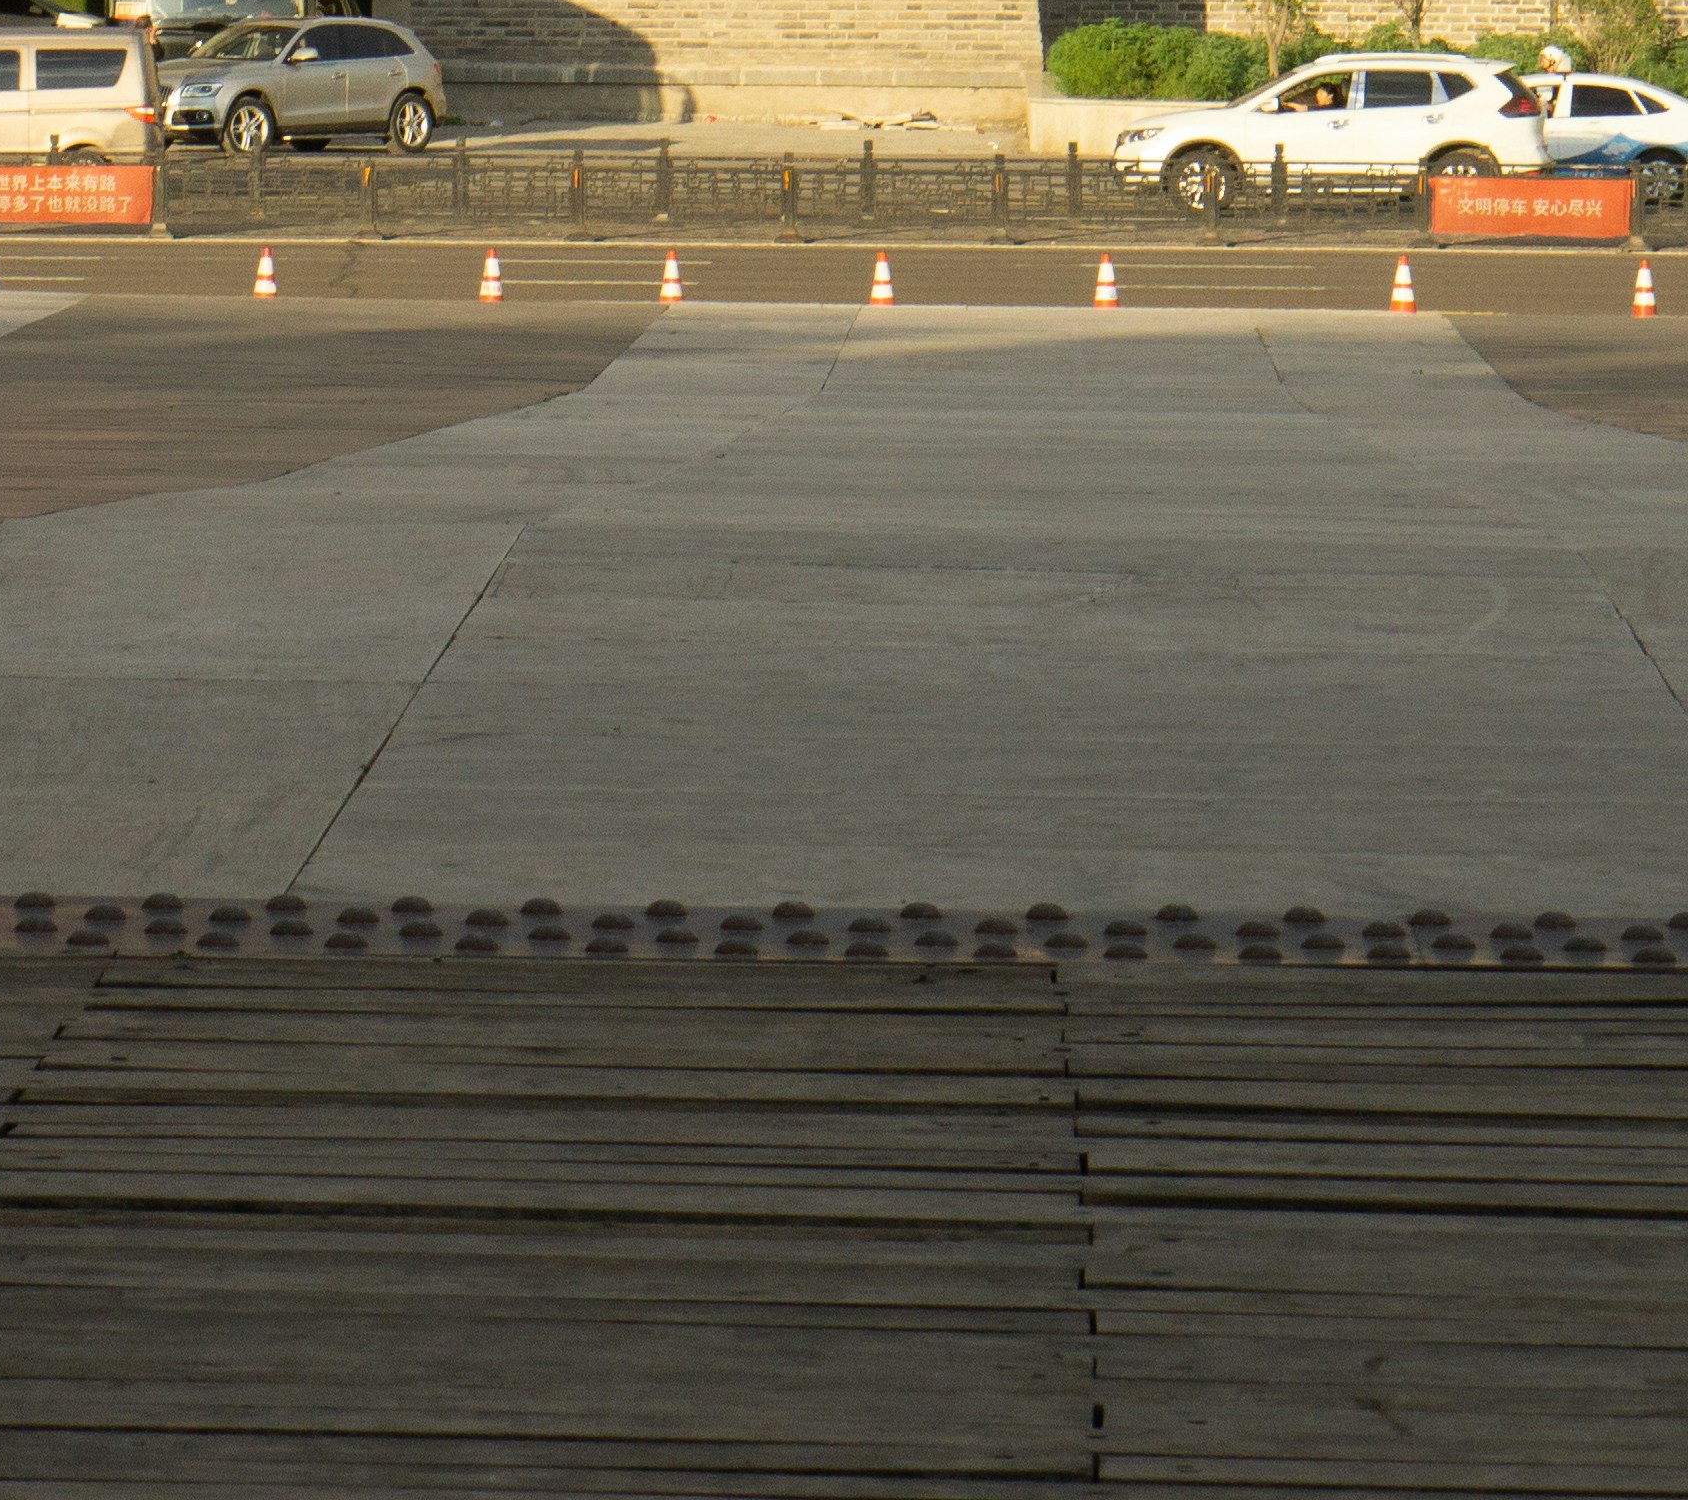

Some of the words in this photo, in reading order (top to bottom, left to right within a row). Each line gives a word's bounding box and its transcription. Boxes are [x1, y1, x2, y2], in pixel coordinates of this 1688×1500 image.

[1458, 198, 1527, 216] 文明停车
[1533, 199, 1602, 217] 安心尽兴
